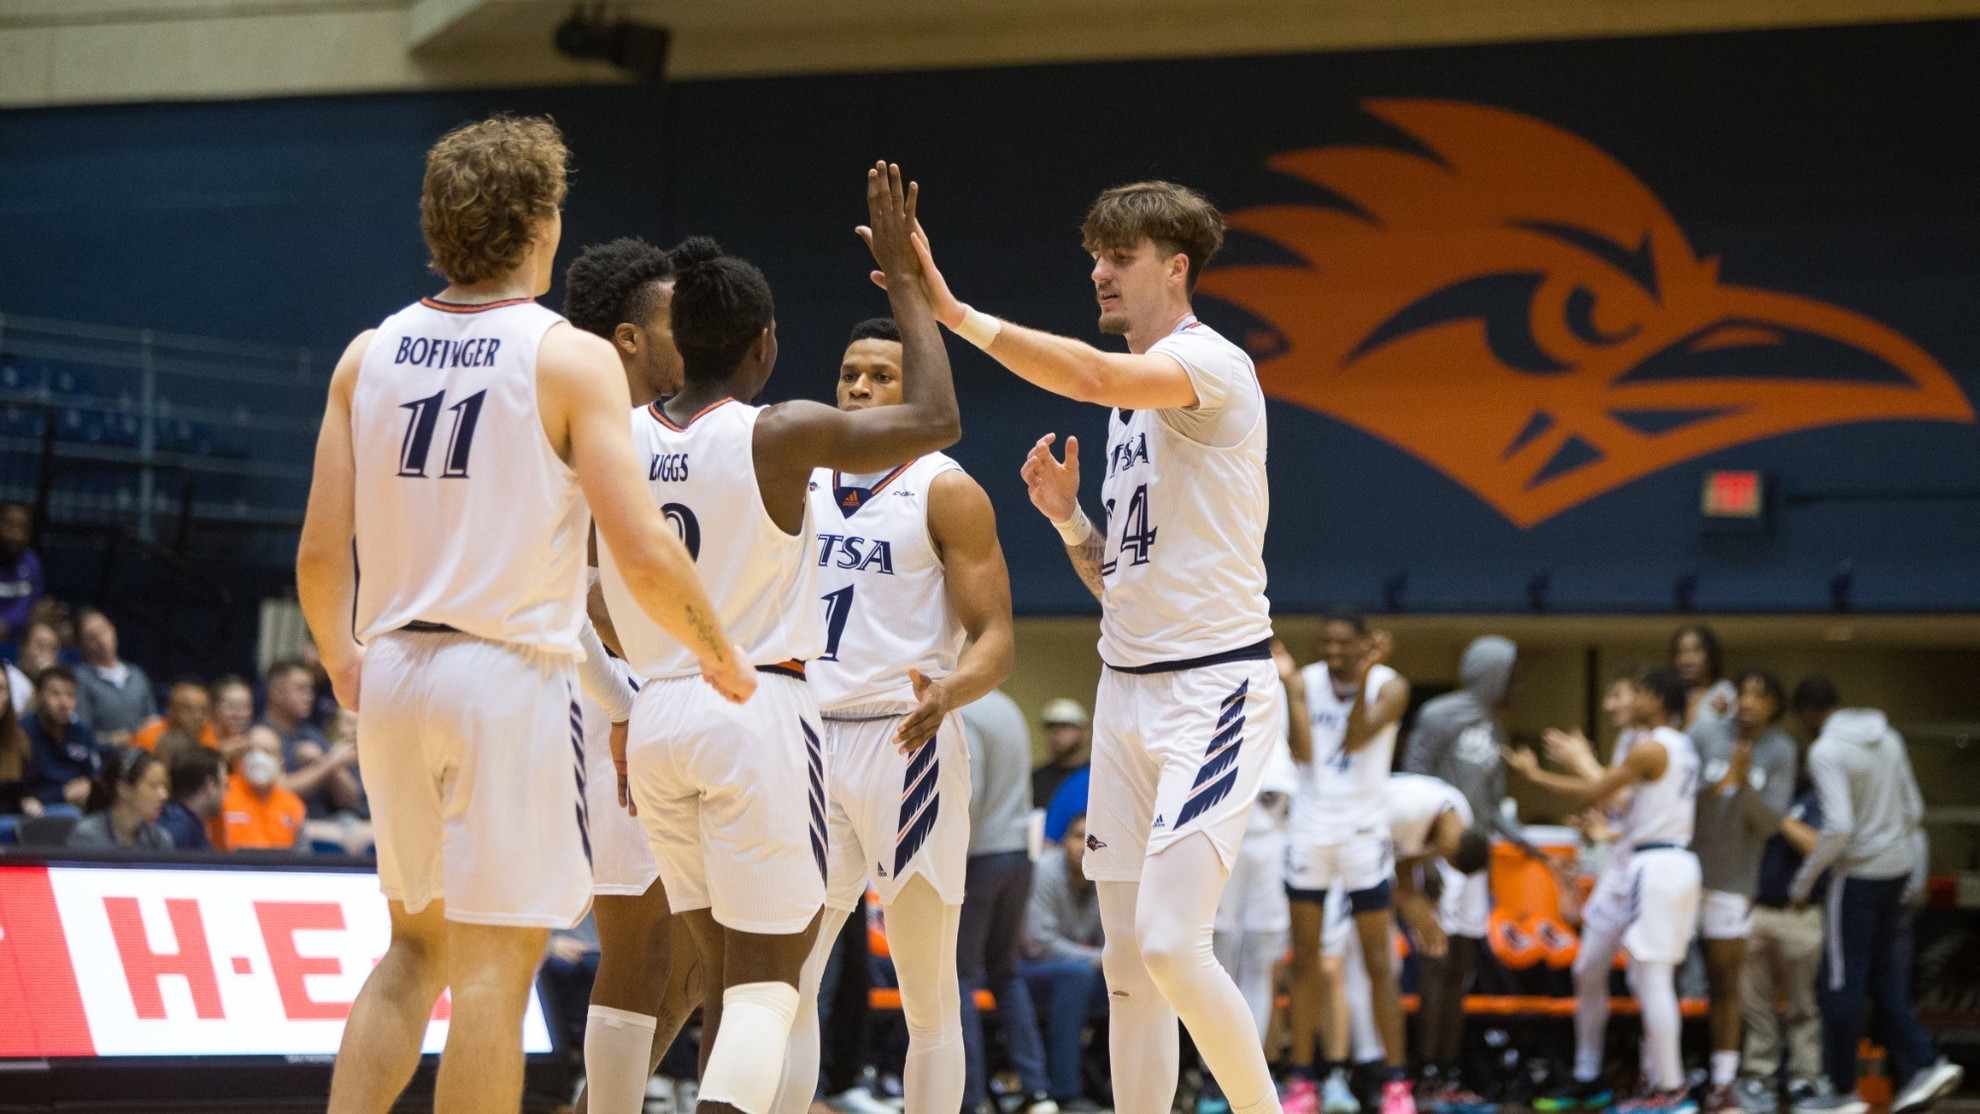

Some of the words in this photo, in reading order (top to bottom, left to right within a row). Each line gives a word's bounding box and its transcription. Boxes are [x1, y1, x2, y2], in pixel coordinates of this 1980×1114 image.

[394, 335, 501, 369] BOFINGER
[395, 388, 488, 479] 11
[1109, 432, 1150, 479] TSA
[817, 533, 896, 576] TSA
[817, 583, 855, 662] 1
